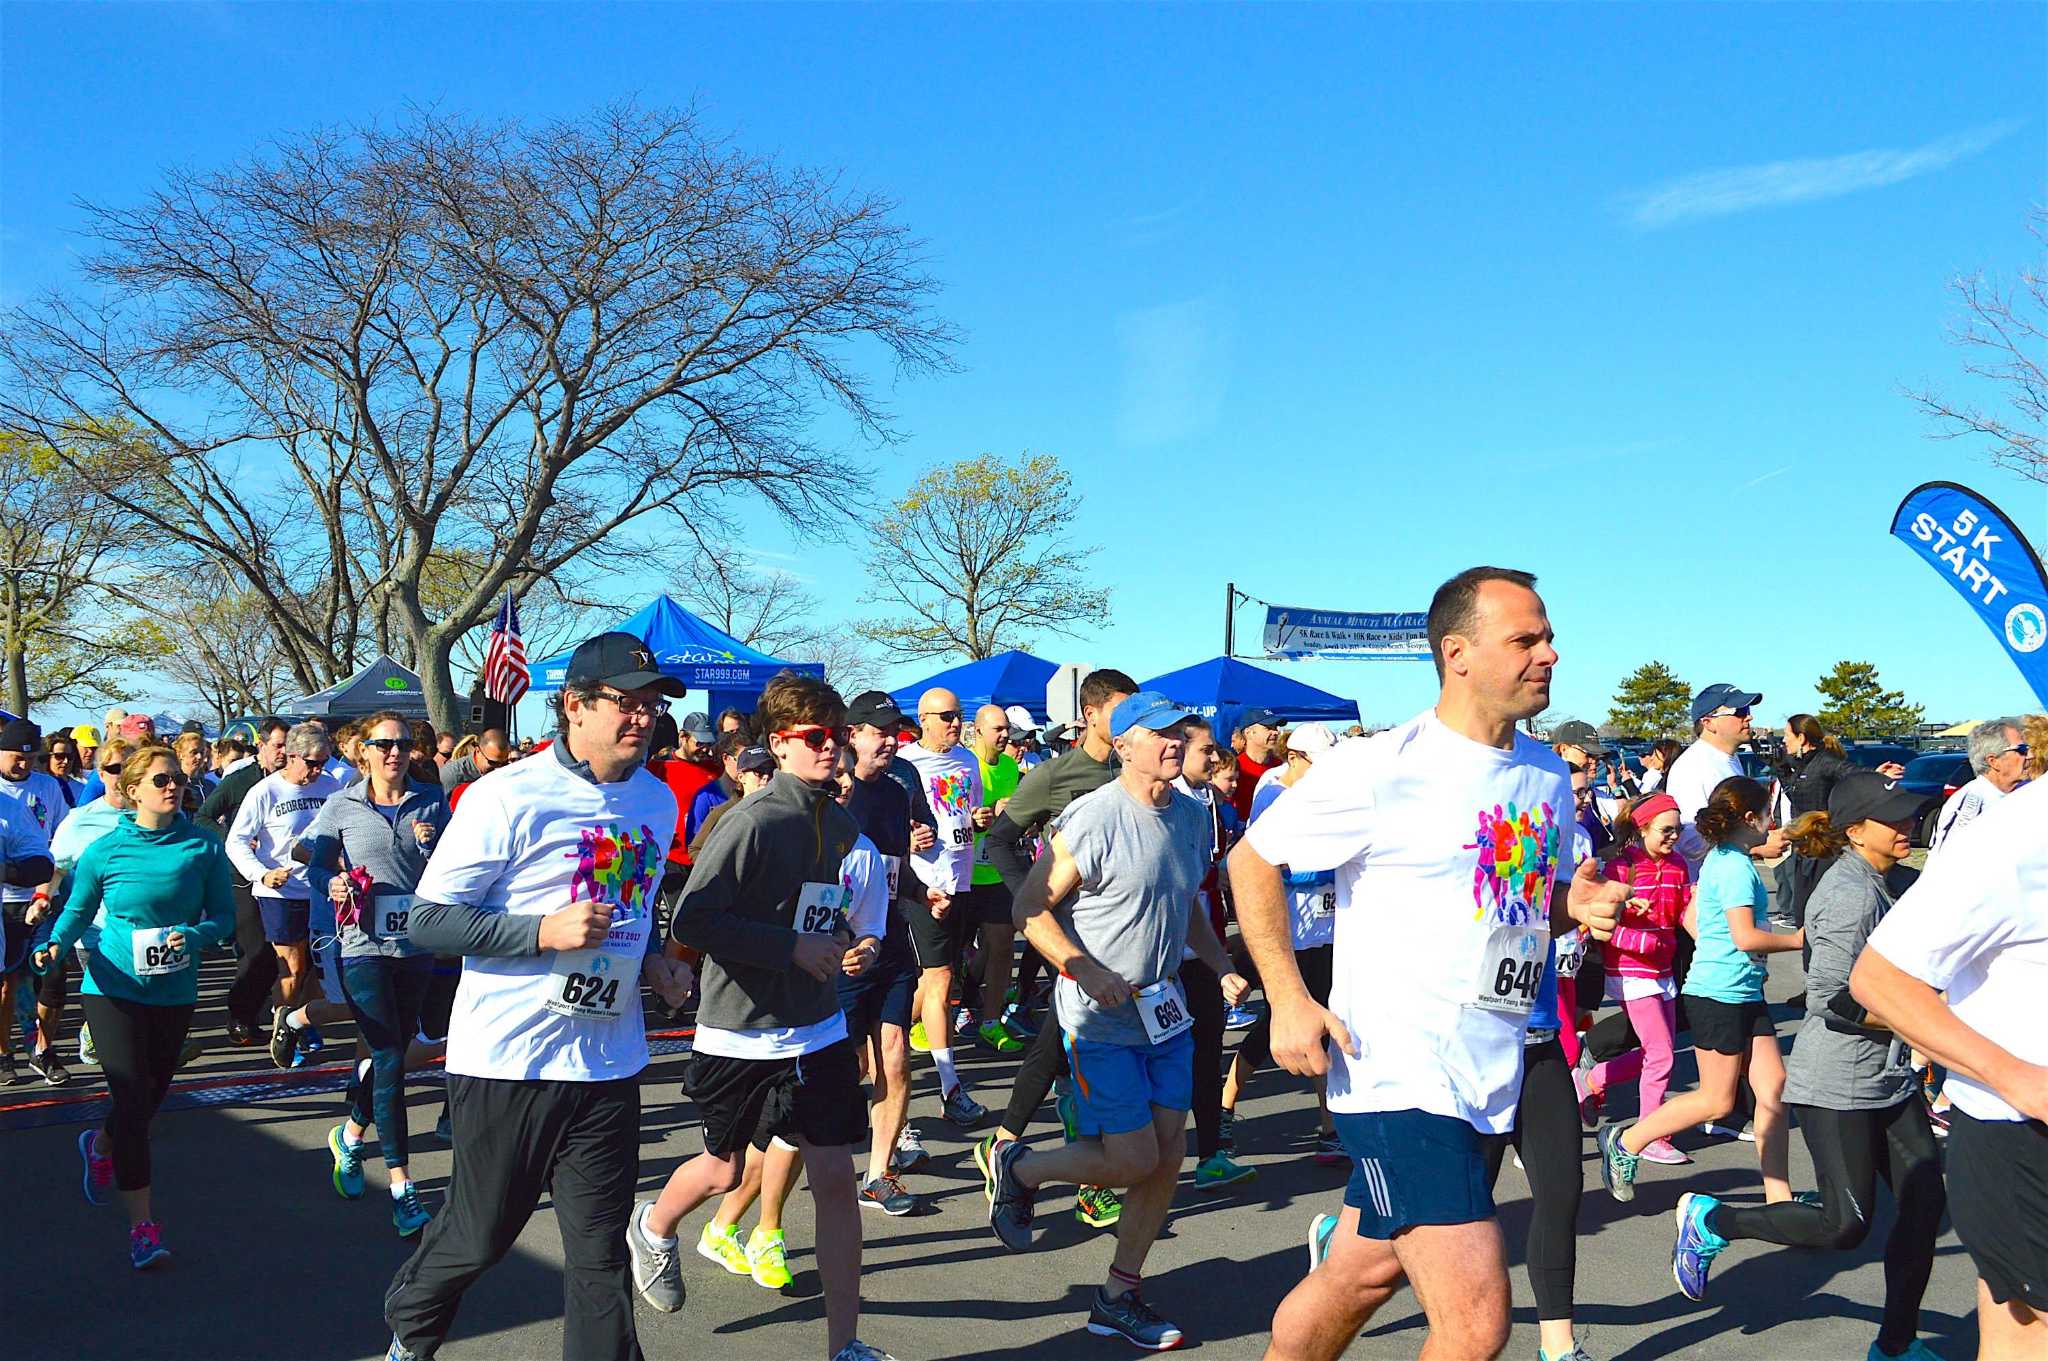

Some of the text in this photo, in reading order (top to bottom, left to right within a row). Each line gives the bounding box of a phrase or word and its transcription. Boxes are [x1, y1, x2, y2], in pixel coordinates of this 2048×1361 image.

[1952, 508, 2002, 561] 5K
[1911, 512, 2008, 605] START
[1366, 632, 1381, 641] Race
[694, 668, 750, 681] STAR999.COM
[1184, 706, 1218, 717] CK-UP
[385, 911, 409, 932] 62
[563, 973, 619, 1009] 624
